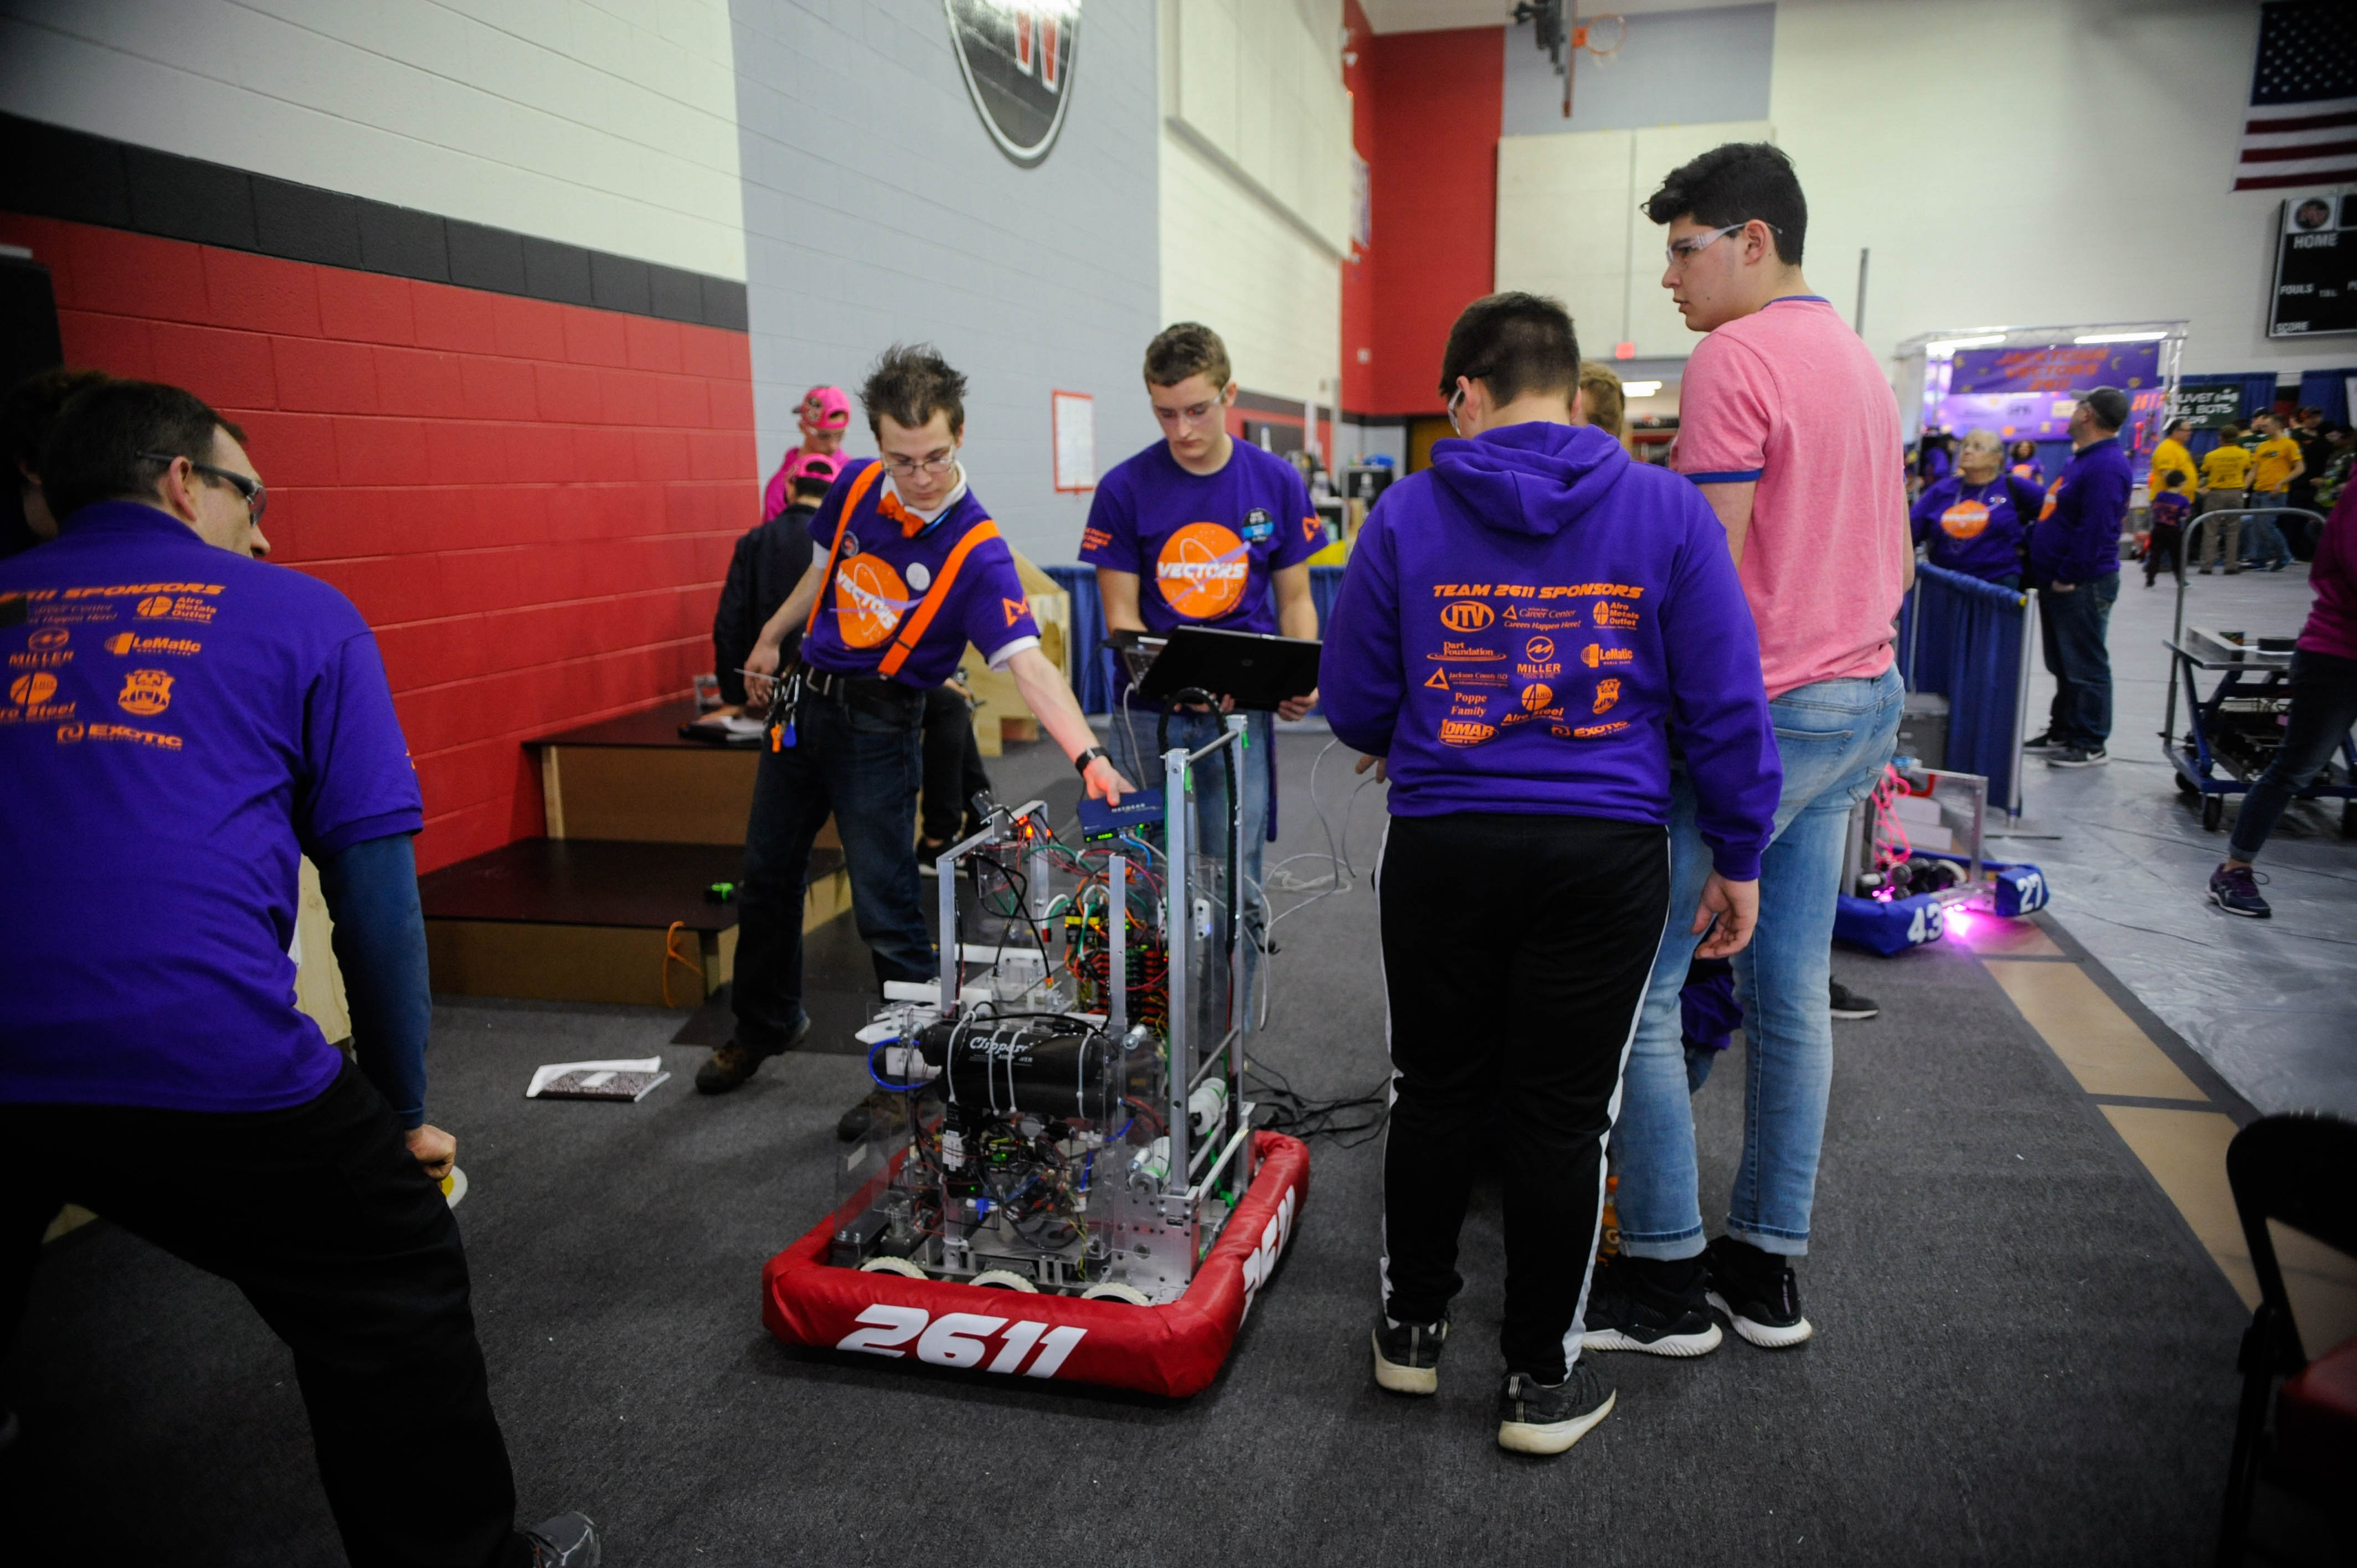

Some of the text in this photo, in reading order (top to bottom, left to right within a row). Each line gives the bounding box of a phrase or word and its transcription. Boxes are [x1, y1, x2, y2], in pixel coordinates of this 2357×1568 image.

[2294, 233, 2338, 249] HOME
[2279, 283, 2314, 295] FOULS
[2276, 321, 2309, 332] SCORE
[2005, 363, 2099, 378] VECTORS
[2196, 404, 2234, 414] BOTS
[1157, 562, 1247, 579] VECTORS
[64, 583, 227, 599] SPONSORS
[1433, 583, 1644, 599] TEAM 2611 SPONSORS
[837, 567, 899, 630] VECTORS
[174, 602, 217, 613] Metals
[1519, 609, 1546, 618] Career
[172, 610, 212, 620] Outlet
[1449, 605, 1486, 627] JTV
[1610, 610, 1639, 620] Metals
[1532, 622, 1559, 631] Happen
[1610, 617, 1636, 626] Outlet
[132, 636, 202, 652] LeMatic
[1444, 647, 1494, 656] Foundation
[1599, 648, 1633, 661] LeMatic
[1517, 663, 1561, 673] MILLER
[1455, 692, 1487, 704] Poppe
[1451, 706, 1486, 718] Family
[89, 723, 183, 746] EXOTIC
[1111, 803, 1145, 813] NETGEAR
[2016, 873, 2044, 914] 27
[1907, 902, 1944, 943] 43
[836, 1303, 1088, 1379] 2611
